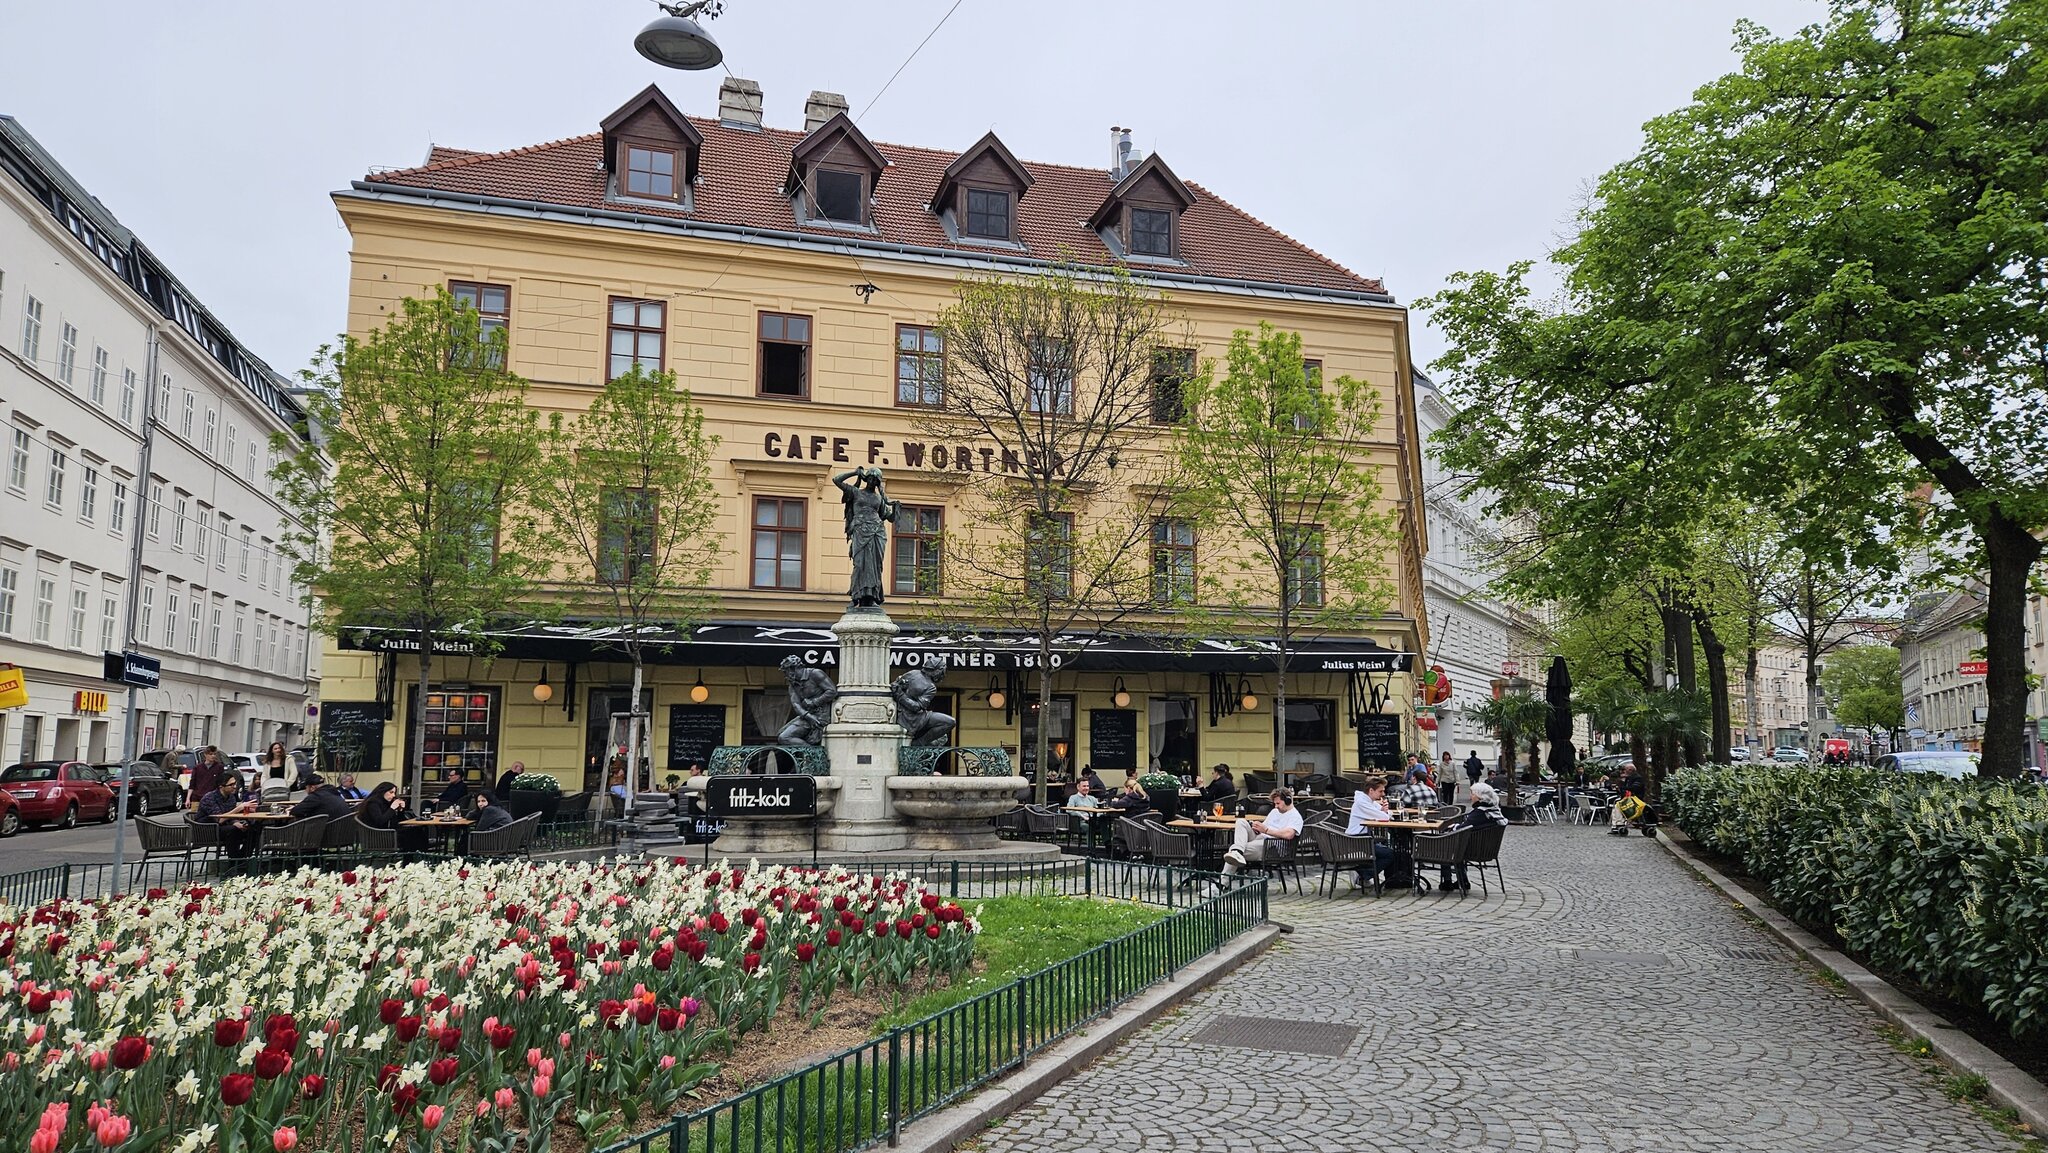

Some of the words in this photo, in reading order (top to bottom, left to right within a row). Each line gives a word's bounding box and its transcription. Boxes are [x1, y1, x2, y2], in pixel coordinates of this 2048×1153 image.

[764, 431, 850, 463] CAFE
[868, 439, 890, 465] F.
[903, 442, 1066, 477] WORTNER
[380, 639, 423, 650] Juliu
[432, 641, 474, 652] Meinl
[804, 649, 837, 665] CA
[1321, 660, 1354, 670] Julius
[1357, 661, 1386, 670] Meinl
[80, 690, 108, 712] BILLA
[728, 787, 791, 808] fritz-kola
